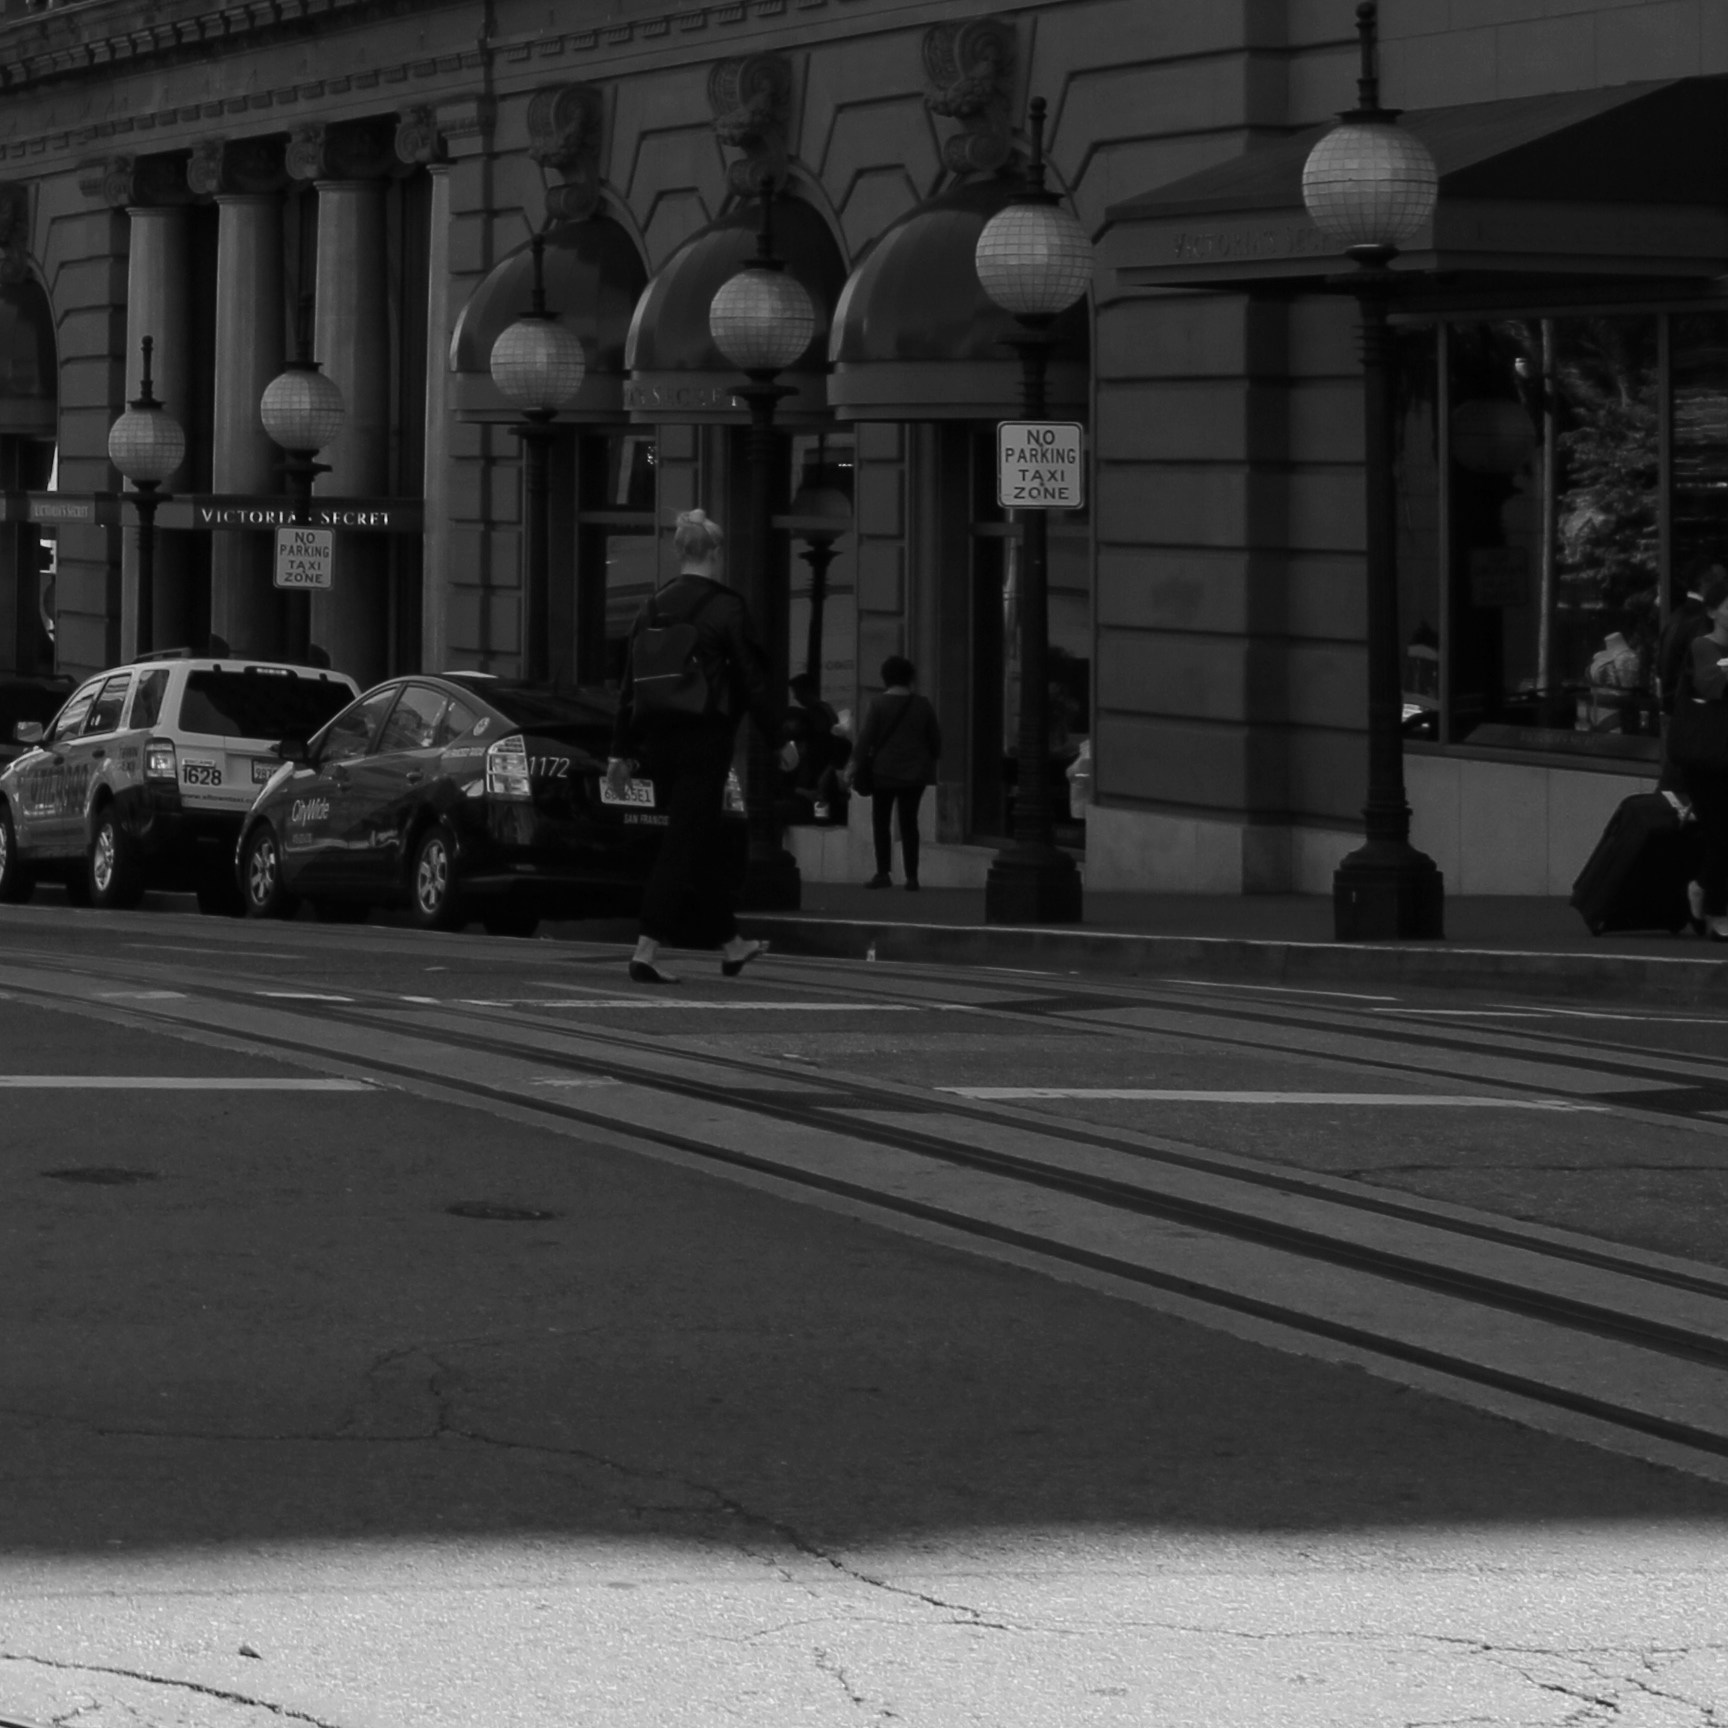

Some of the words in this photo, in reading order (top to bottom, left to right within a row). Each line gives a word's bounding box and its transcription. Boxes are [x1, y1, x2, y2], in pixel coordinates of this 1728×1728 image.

[1027, 429, 1055, 446] NO
[1005, 447, 1076, 464] PARKING
[1018, 469, 1065, 482] TAXI
[1013, 486, 1069, 500] ZONE
[320, 510, 391, 527] SECRET
[294, 531, 316, 545] NO
[279, 544, 330, 559] PARKING
[288, 559, 322, 571] TAXI
[284, 572, 323, 584] ZONE
[530, 756, 570, 778] 1172
[183, 766, 222, 786] 1628
[292, 797, 331, 827] CityWide
